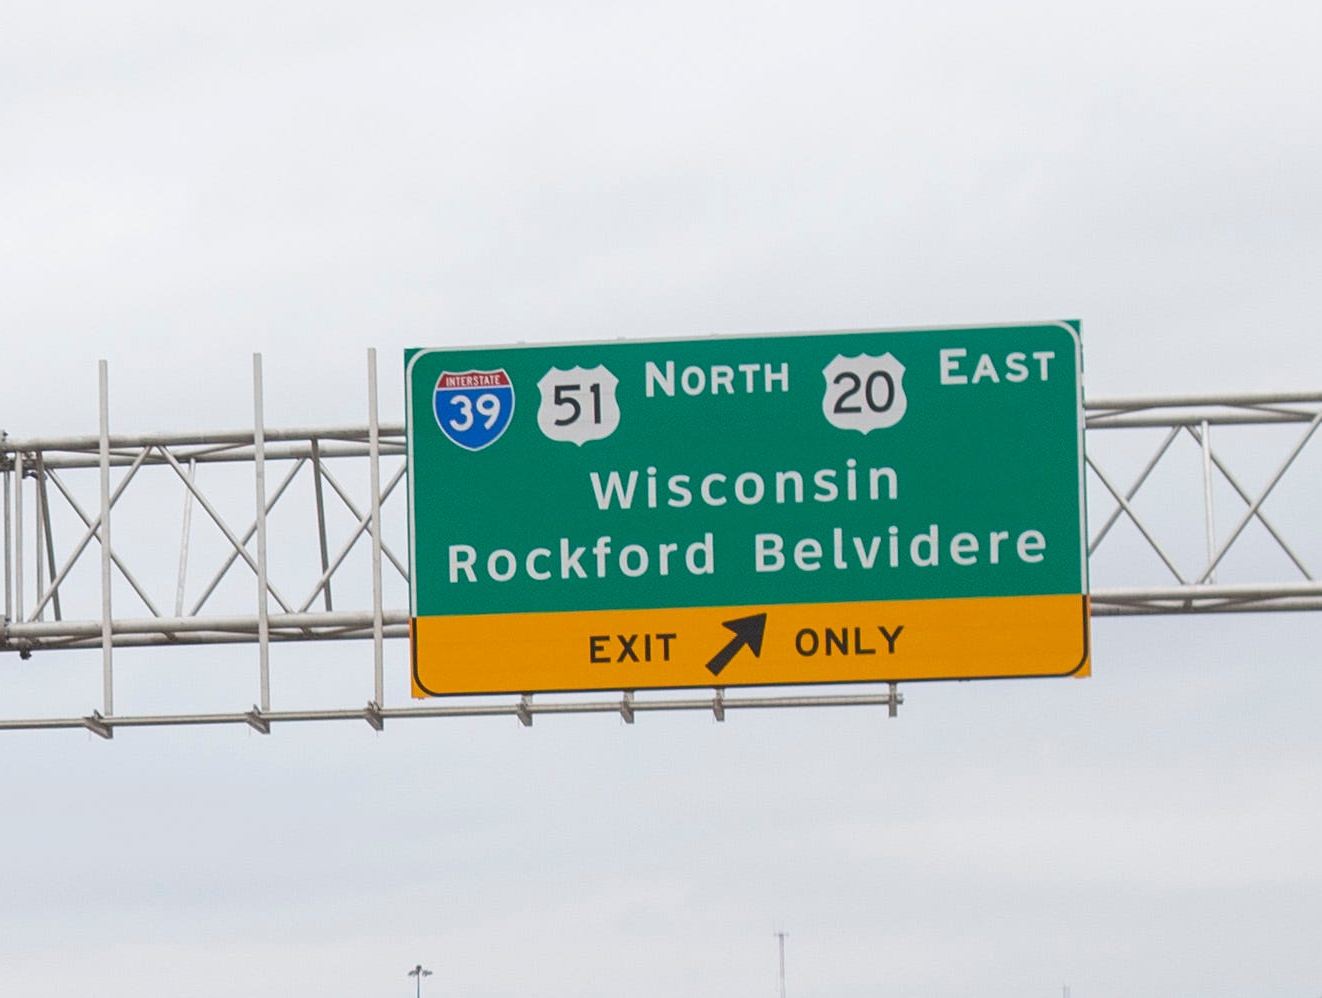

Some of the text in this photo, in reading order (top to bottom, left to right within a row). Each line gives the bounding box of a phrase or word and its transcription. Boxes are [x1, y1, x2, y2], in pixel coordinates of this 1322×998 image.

[446, 374, 501, 387] INTERSTATE
[450, 348, 1055, 432] 39 51 NORTH 20 EAST
[589, 458, 898, 510] Wisconsin
[448, 524, 1046, 583] Rockford Belvidere
[589, 625, 904, 664] EXIT ONLY
